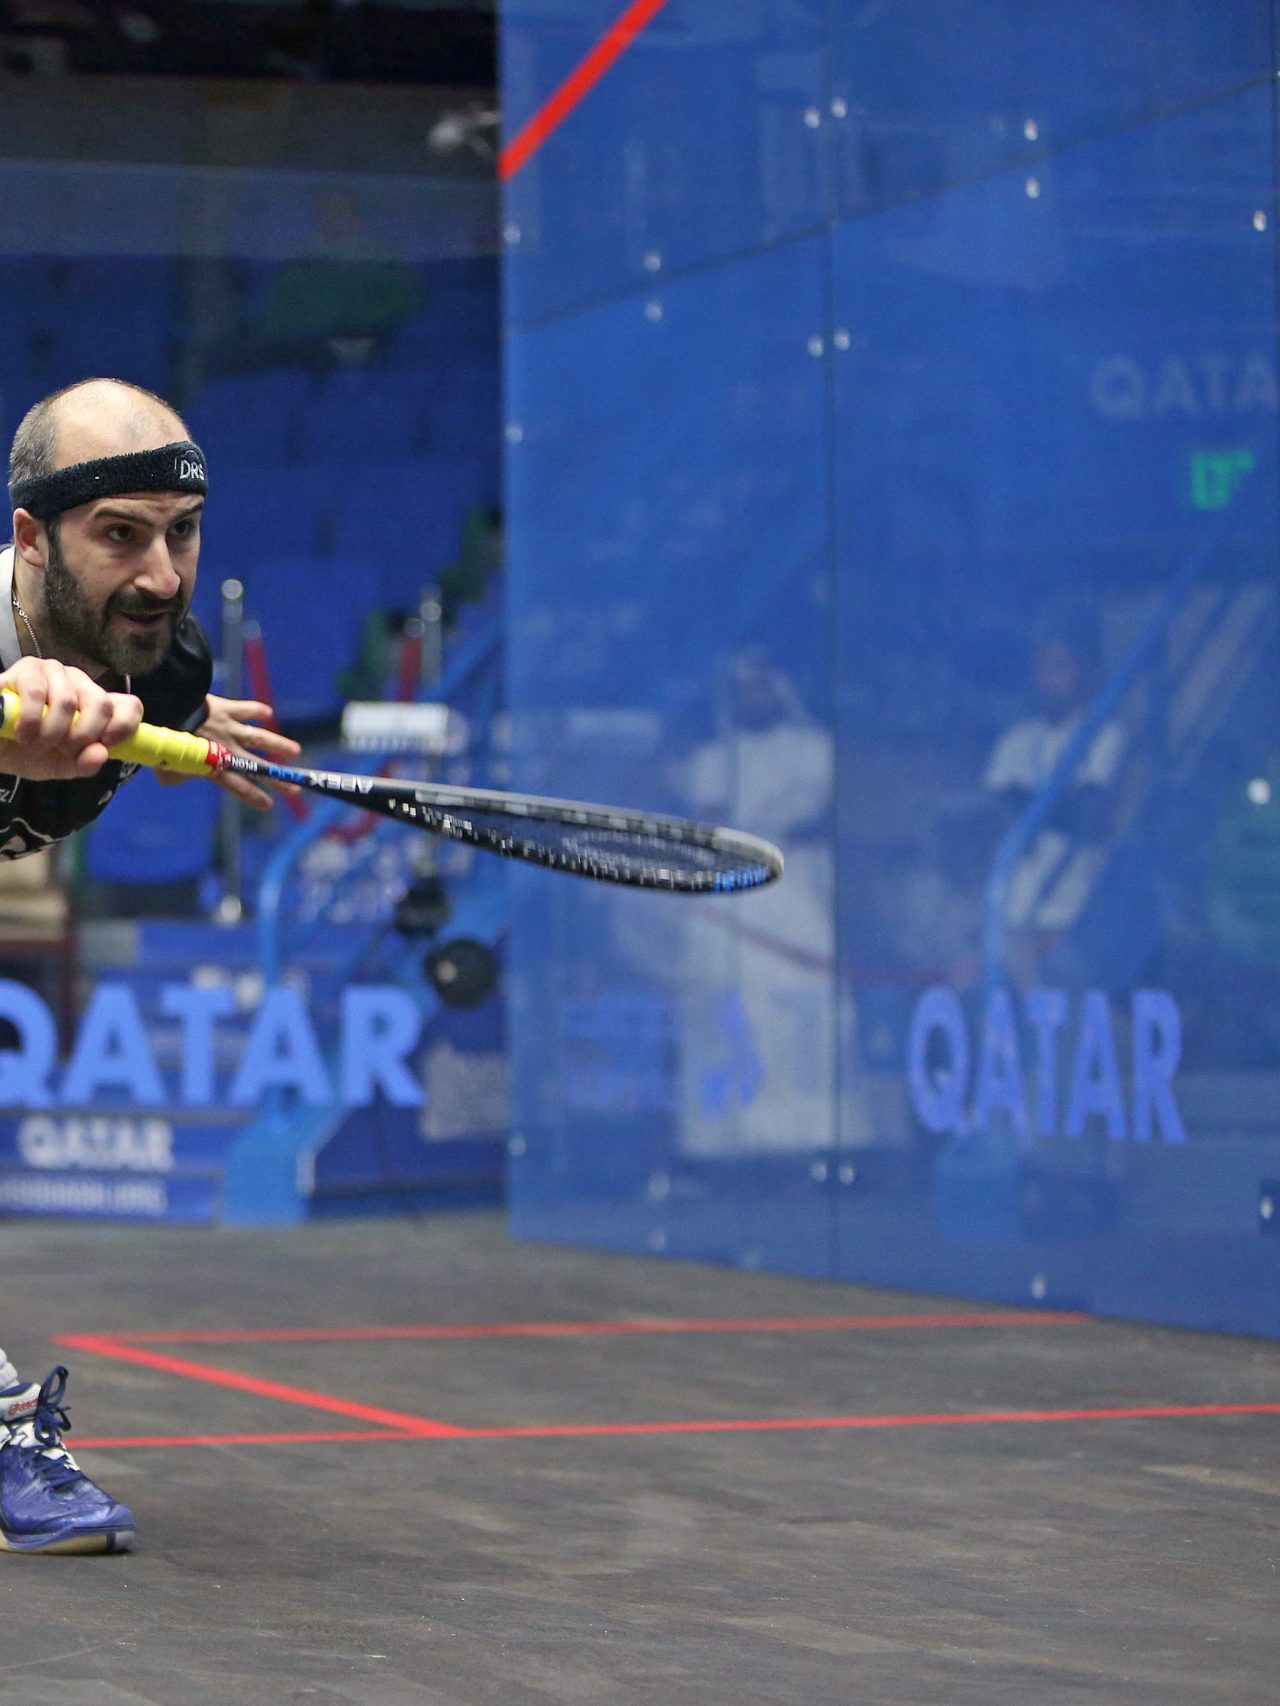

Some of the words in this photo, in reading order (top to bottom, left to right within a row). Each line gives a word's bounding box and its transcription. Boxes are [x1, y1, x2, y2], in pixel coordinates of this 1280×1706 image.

[180, 460, 204, 480] DRS
[308, 771, 374, 795] APEX
[907, 985, 1188, 1144] QATAR
